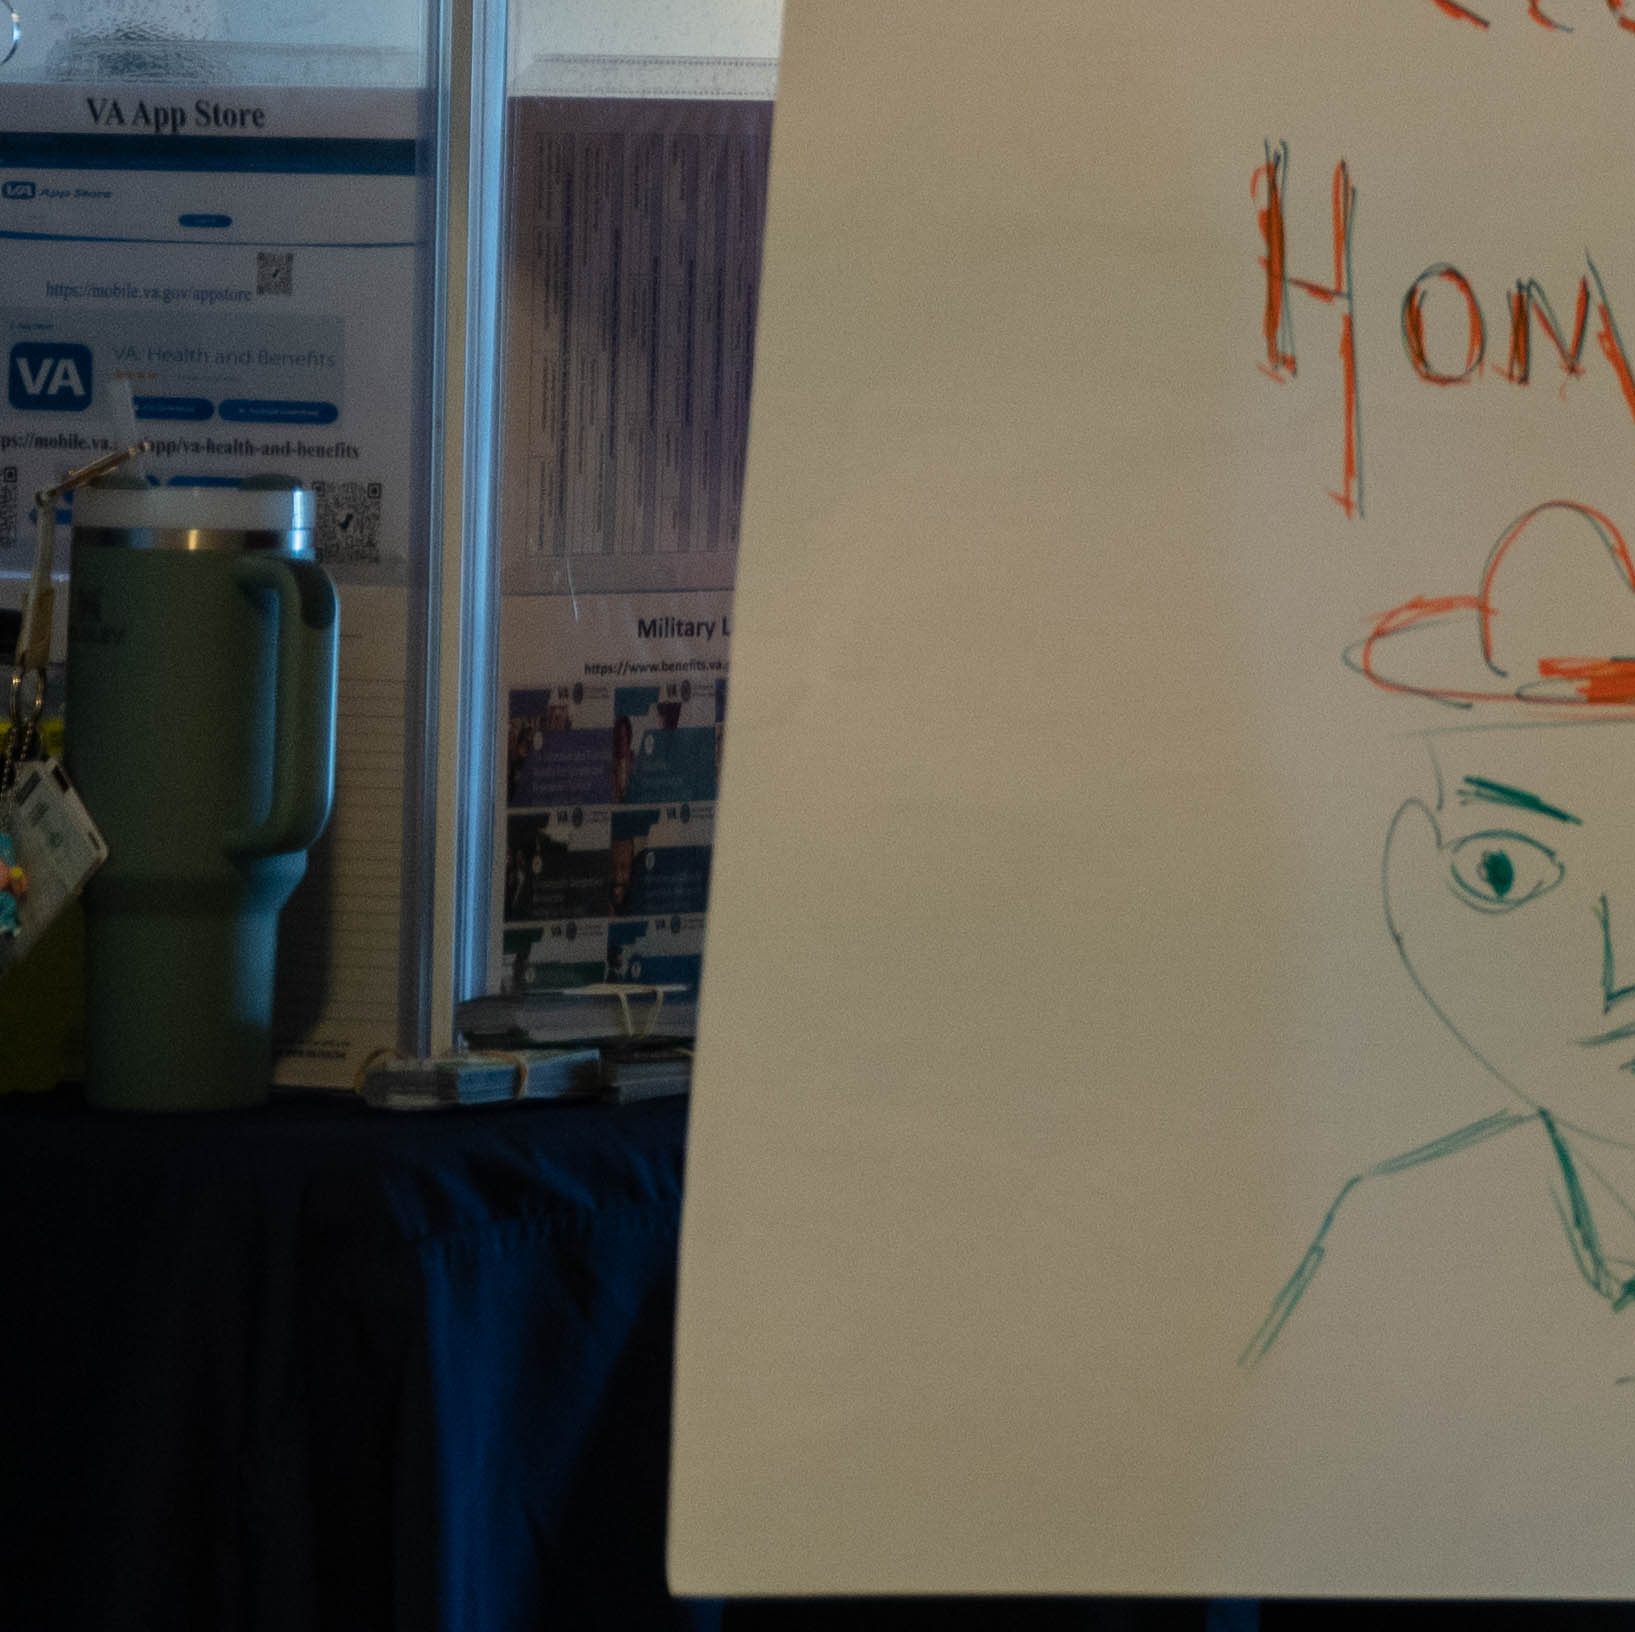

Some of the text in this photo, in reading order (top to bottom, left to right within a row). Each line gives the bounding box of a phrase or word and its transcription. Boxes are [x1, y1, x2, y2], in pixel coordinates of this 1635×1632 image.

[86, 96, 267, 133] VA App Store
[147, 345, 208, 363] Health
[215, 348, 251, 366] and
[257, 348, 337, 368] Benefits
[15, 357, 88, 397] VA
[637, 615, 715, 643] Military
